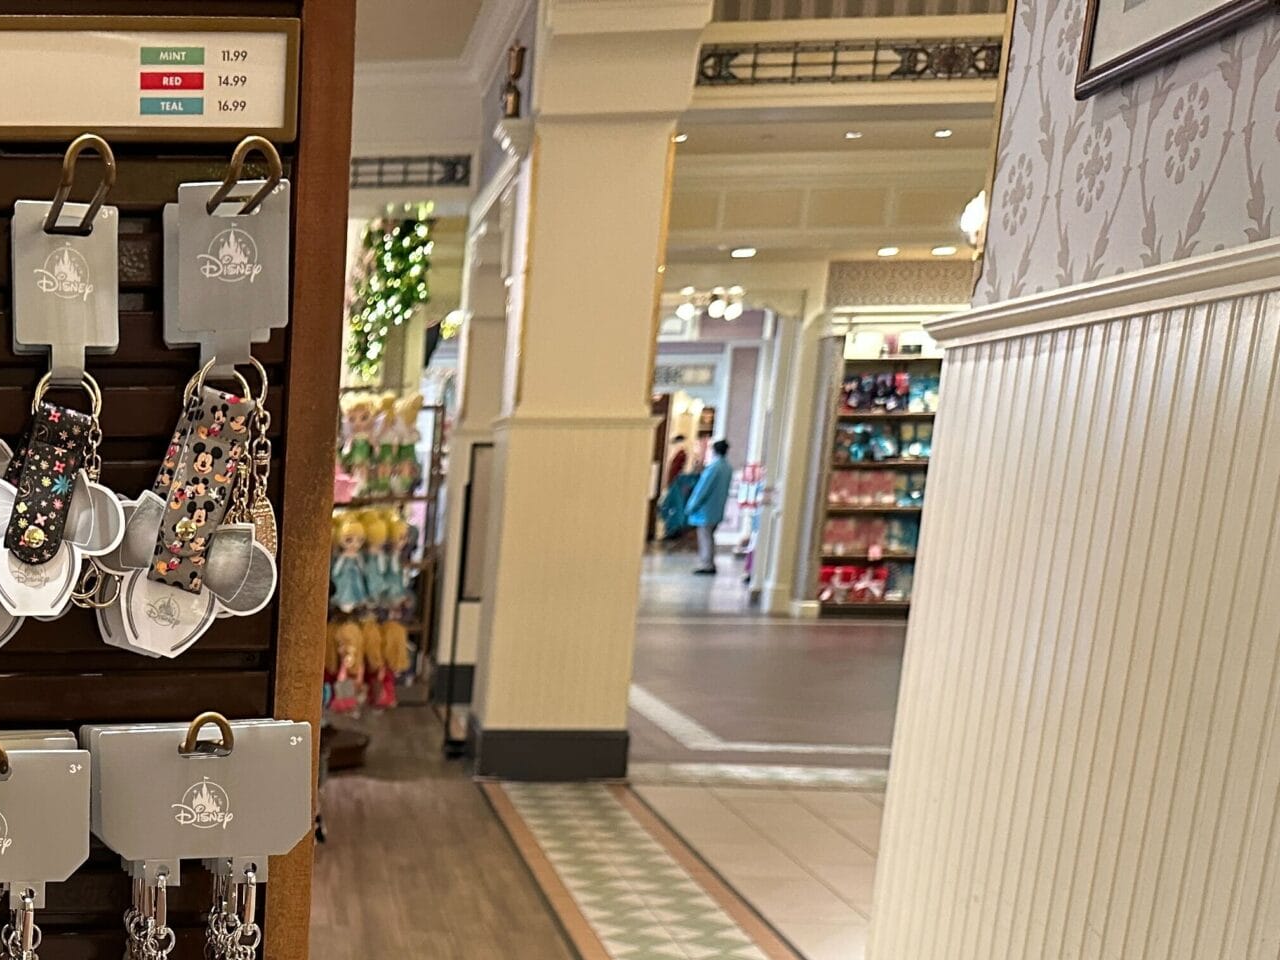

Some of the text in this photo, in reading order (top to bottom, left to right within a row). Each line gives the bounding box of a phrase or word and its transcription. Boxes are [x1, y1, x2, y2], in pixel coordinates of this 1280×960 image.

[160, 50, 248, 61] MINT 11.99
[162, 75, 247, 86] RED 14.99
[160, 100, 247, 111] TEAL 16.99
[101, 208, 114, 220] 3+
[197, 253, 262, 283] Disney
[33, 268, 94, 302] Disney
[289, 735, 304, 746] 3+
[69, 763, 83, 774] 3+
[171, 803, 234, 830] Disney
